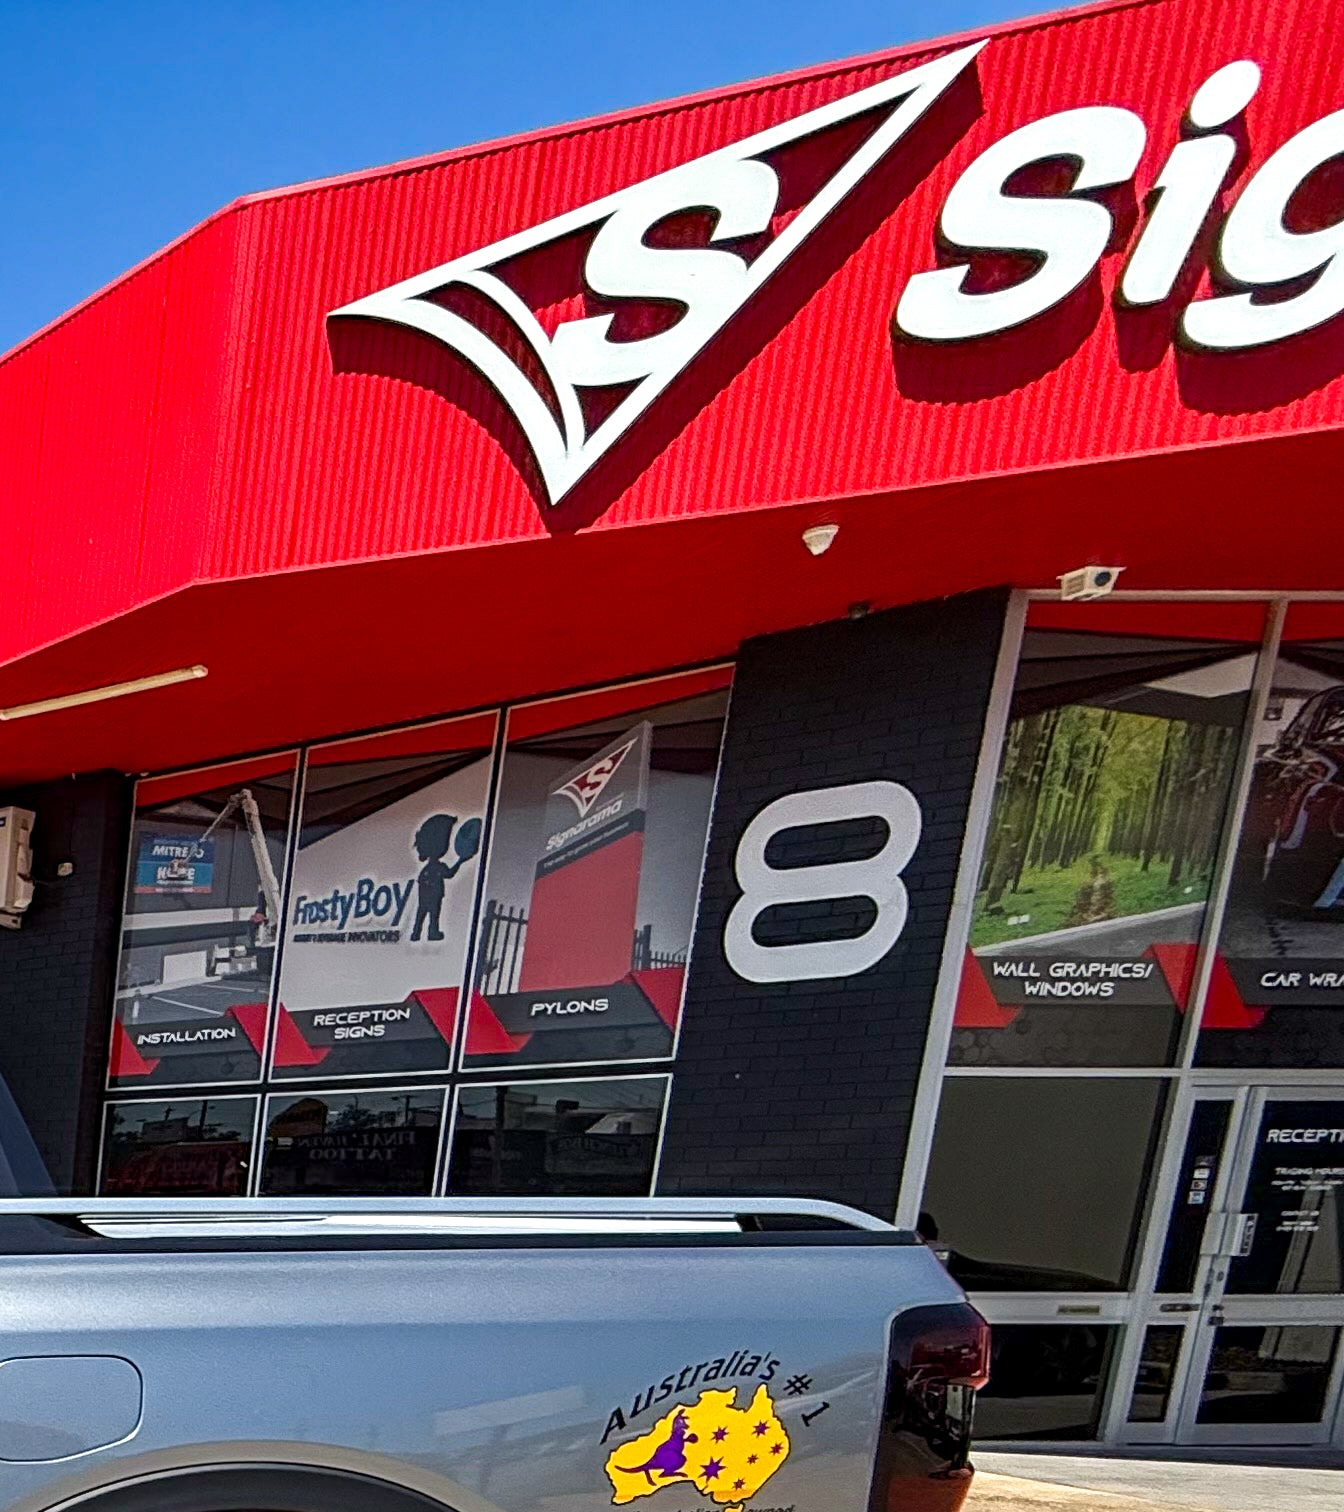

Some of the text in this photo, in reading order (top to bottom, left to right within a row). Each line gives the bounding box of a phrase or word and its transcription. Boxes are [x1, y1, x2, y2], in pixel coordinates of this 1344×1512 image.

[157, 866, 195, 880] HE
[723, 780, 922, 984] 8
[993, 962, 1040, 977] WALL
[1260, 972, 1302, 987] CAR
[1024, 981, 1115, 997] WINDOWS
[531, 998, 609, 1017] PYLONS
[313, 1007, 411, 1026] RECEPTION
[137, 1027, 236, 1046] INSTALLATION
[333, 1024, 386, 1040] SIGNS
[599, 1350, 781, 1446] Australia's
